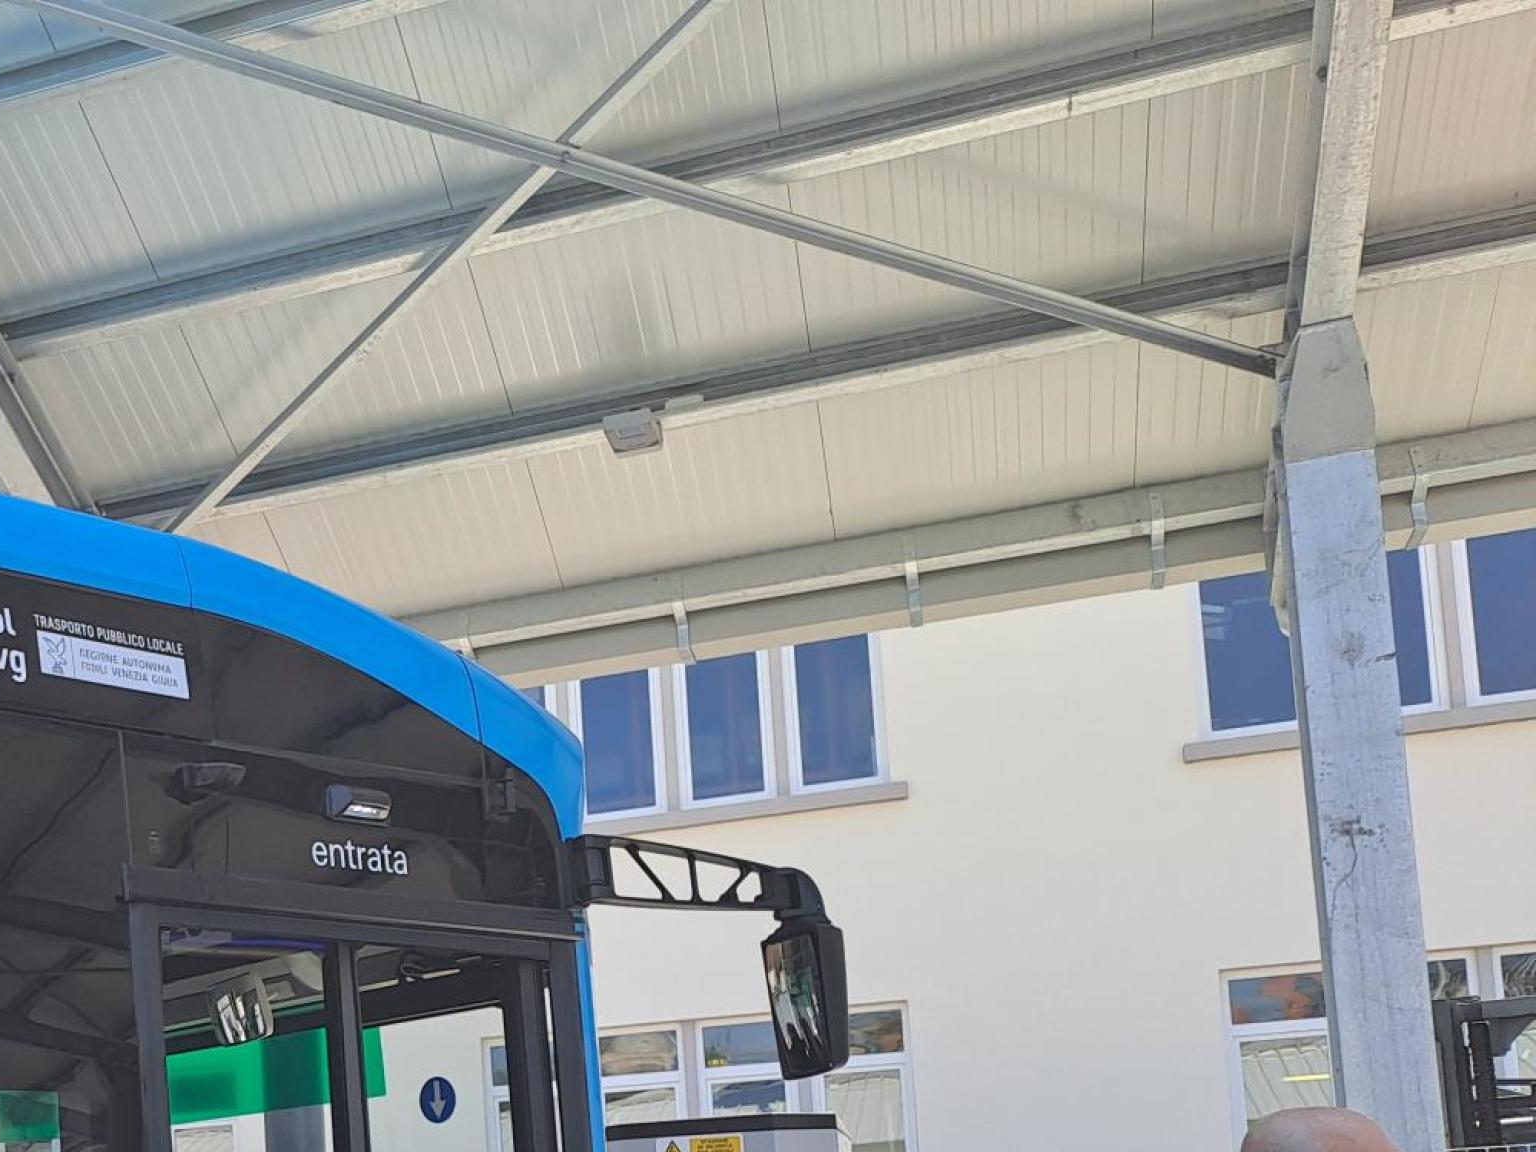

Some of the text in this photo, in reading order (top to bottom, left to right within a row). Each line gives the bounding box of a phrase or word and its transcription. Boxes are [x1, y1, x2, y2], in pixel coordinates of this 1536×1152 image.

[32, 614, 184, 655] TRASPORTO PUBBLICO LOCALE
[111, 667, 149, 682] VENEZIA
[311, 840, 409, 875] entrata
